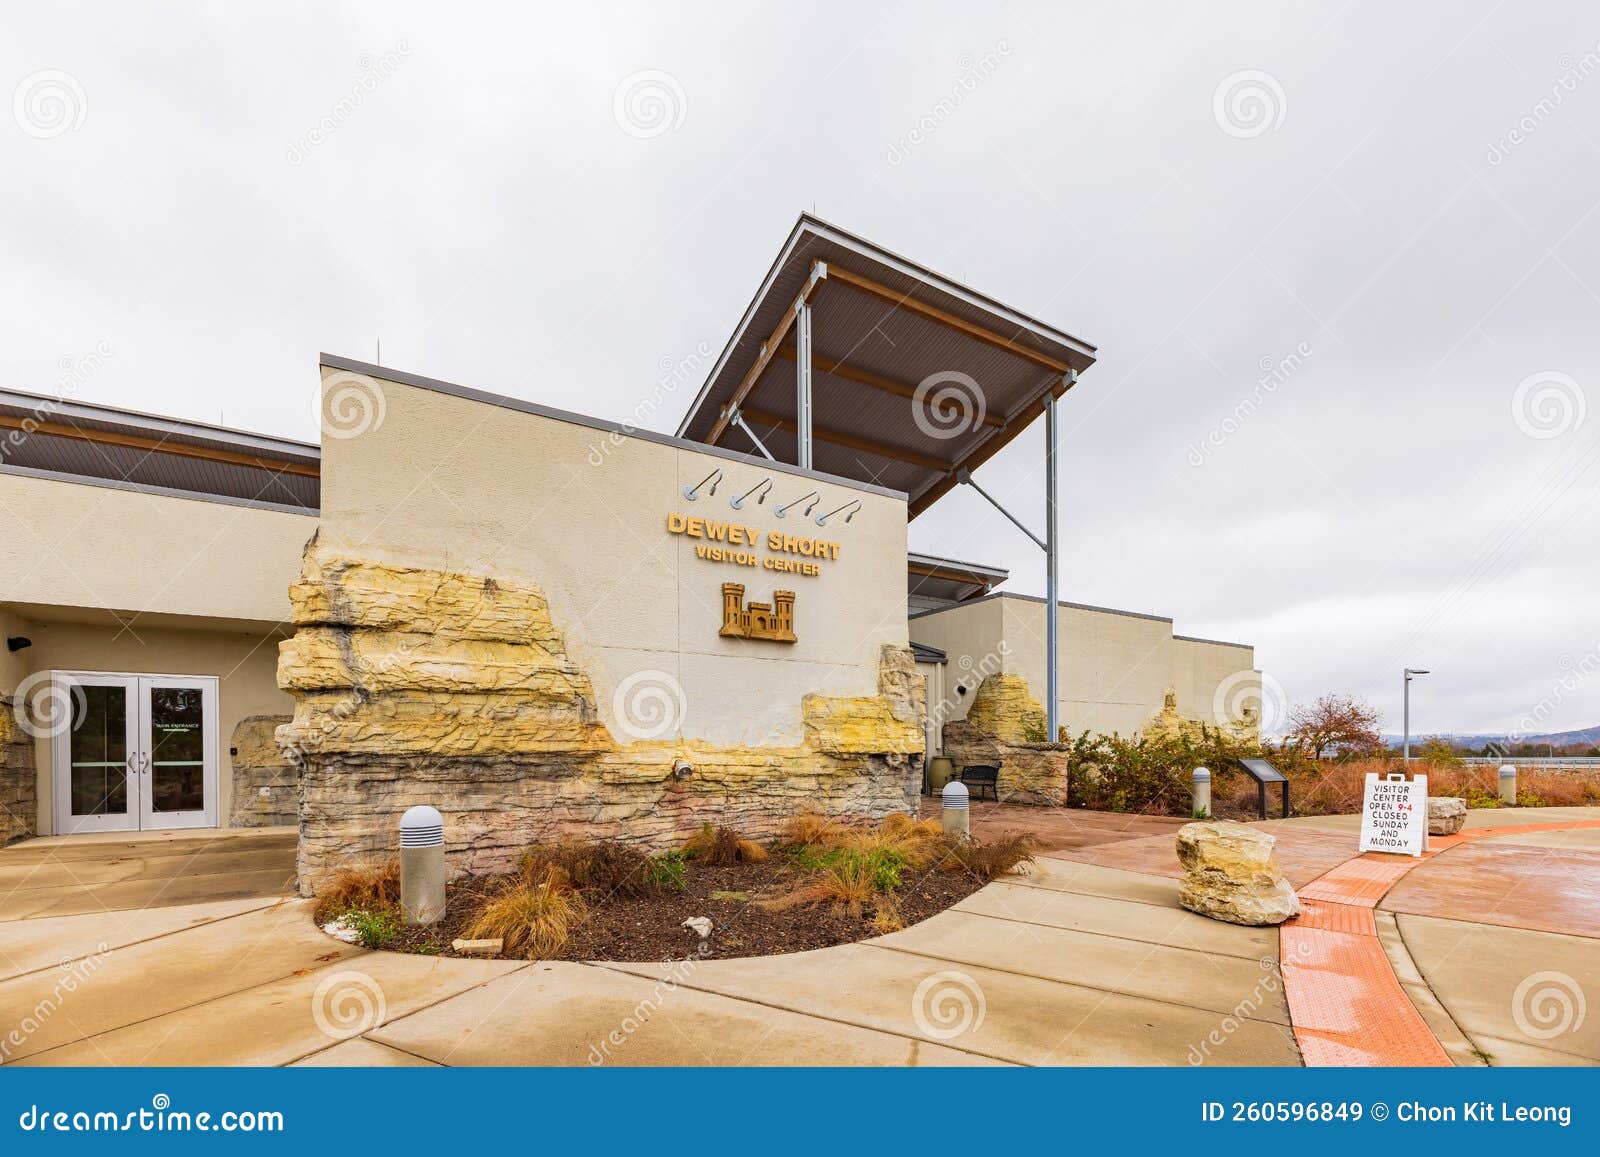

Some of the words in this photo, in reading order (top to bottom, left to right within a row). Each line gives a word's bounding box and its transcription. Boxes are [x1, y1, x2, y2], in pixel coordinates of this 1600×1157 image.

[667, 511, 760, 546] DEWEY
[768, 530, 842, 561] SHORT
[696, 543, 759, 567] VISITOR
[763, 556, 822, 577] CENTER
[1374, 785, 1410, 794] VISITOR
[1373, 793, 1409, 802] CENTER
[1369, 802, 1393, 811] OPEN
[1397, 803, 1413, 812] 9-4
[1372, 811, 1408, 820] CLOSED
[1372, 820, 1409, 829] SUNDAY
[1380, 829, 1399, 838] AND
[1370, 837, 1409, 848] MONDAY
